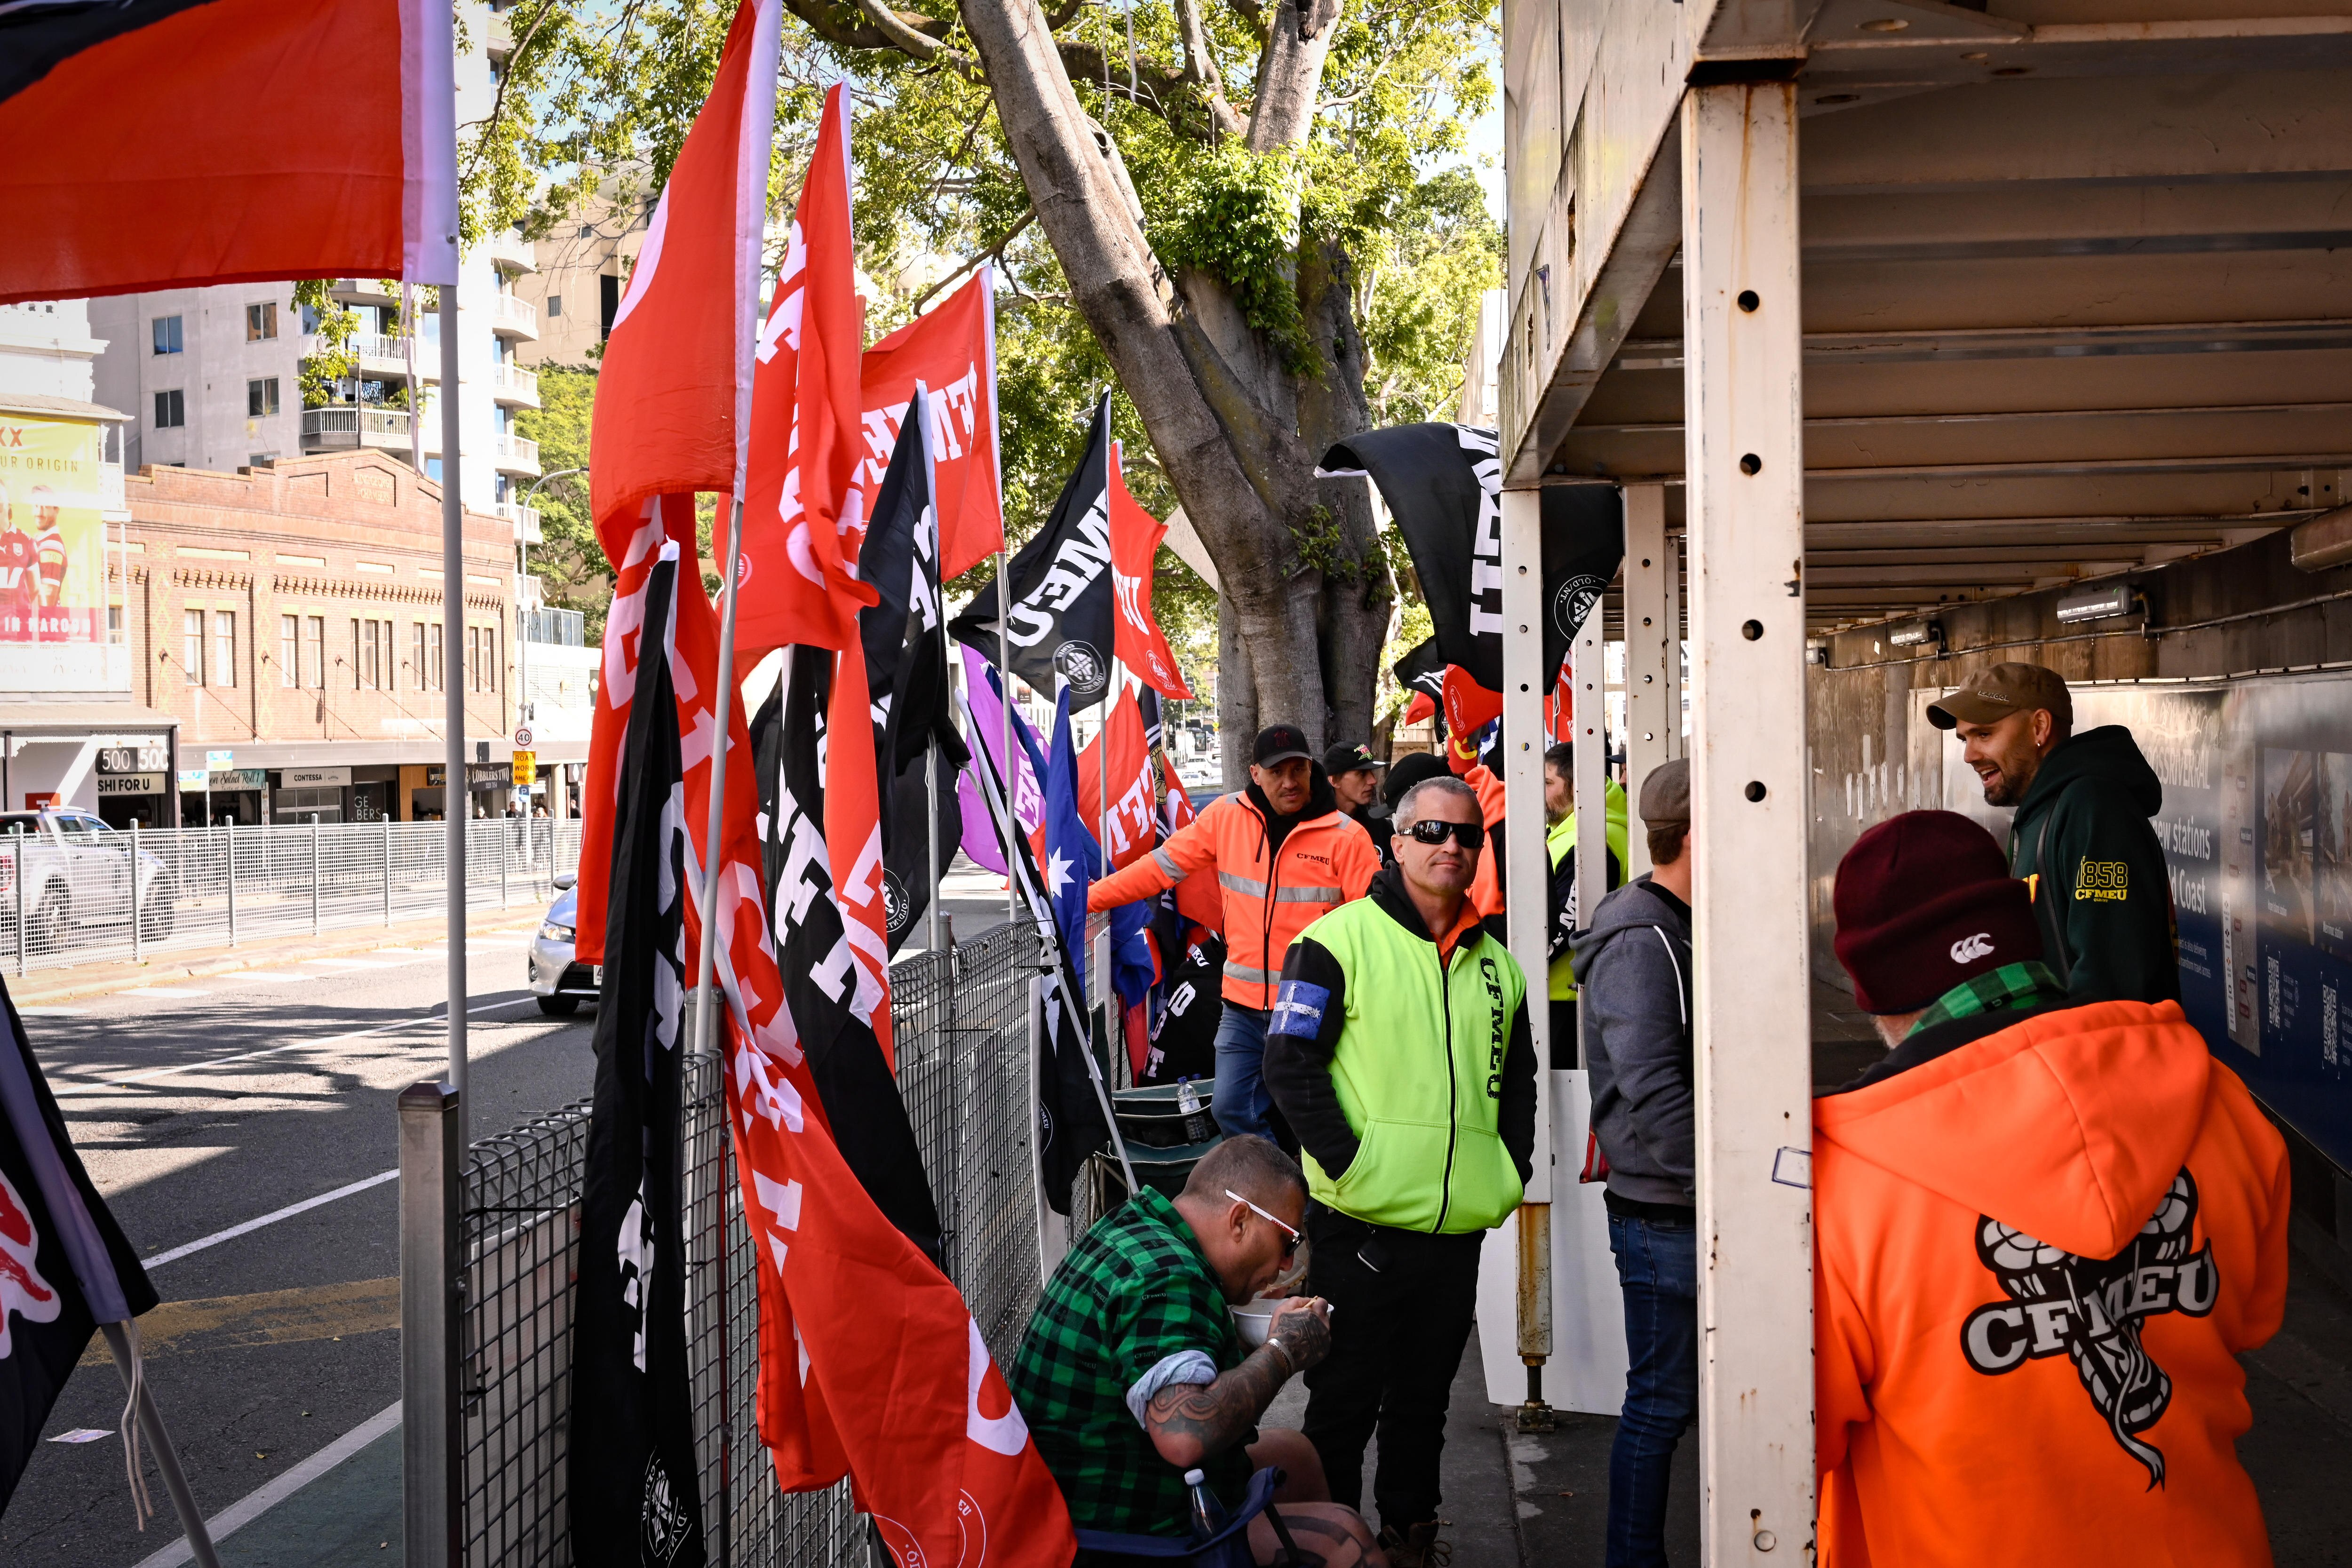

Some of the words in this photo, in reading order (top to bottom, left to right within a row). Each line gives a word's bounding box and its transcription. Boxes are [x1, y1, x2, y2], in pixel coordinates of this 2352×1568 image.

[26, 457, 78, 472] ORIGIN
[102, 750, 130, 770] 500
[220, 771, 240, 785] Salad
[241, 771, 255, 784] Roll
[472, 768, 498, 784] COBBLERS
[498, 766, 509, 782] TWO
[98, 779, 116, 792] SHI
[119, 779, 140, 792] FOR
[143, 779, 150, 790] U
[2173, 815, 2210, 860] stations
[1296, 852, 1330, 865] CFMEU
[2076, 860, 2128, 888] 1858
[2075, 889, 2128, 901] CFMEU
[2179, 868, 2206, 915] Coast
[1480, 957, 1505, 1099] CFMEU
[1141, 1291, 1167, 1301] CFMEU
[1967, 1246, 2217, 1369] CFMEU
[1134, 1351, 1157, 1360] CFMEU
